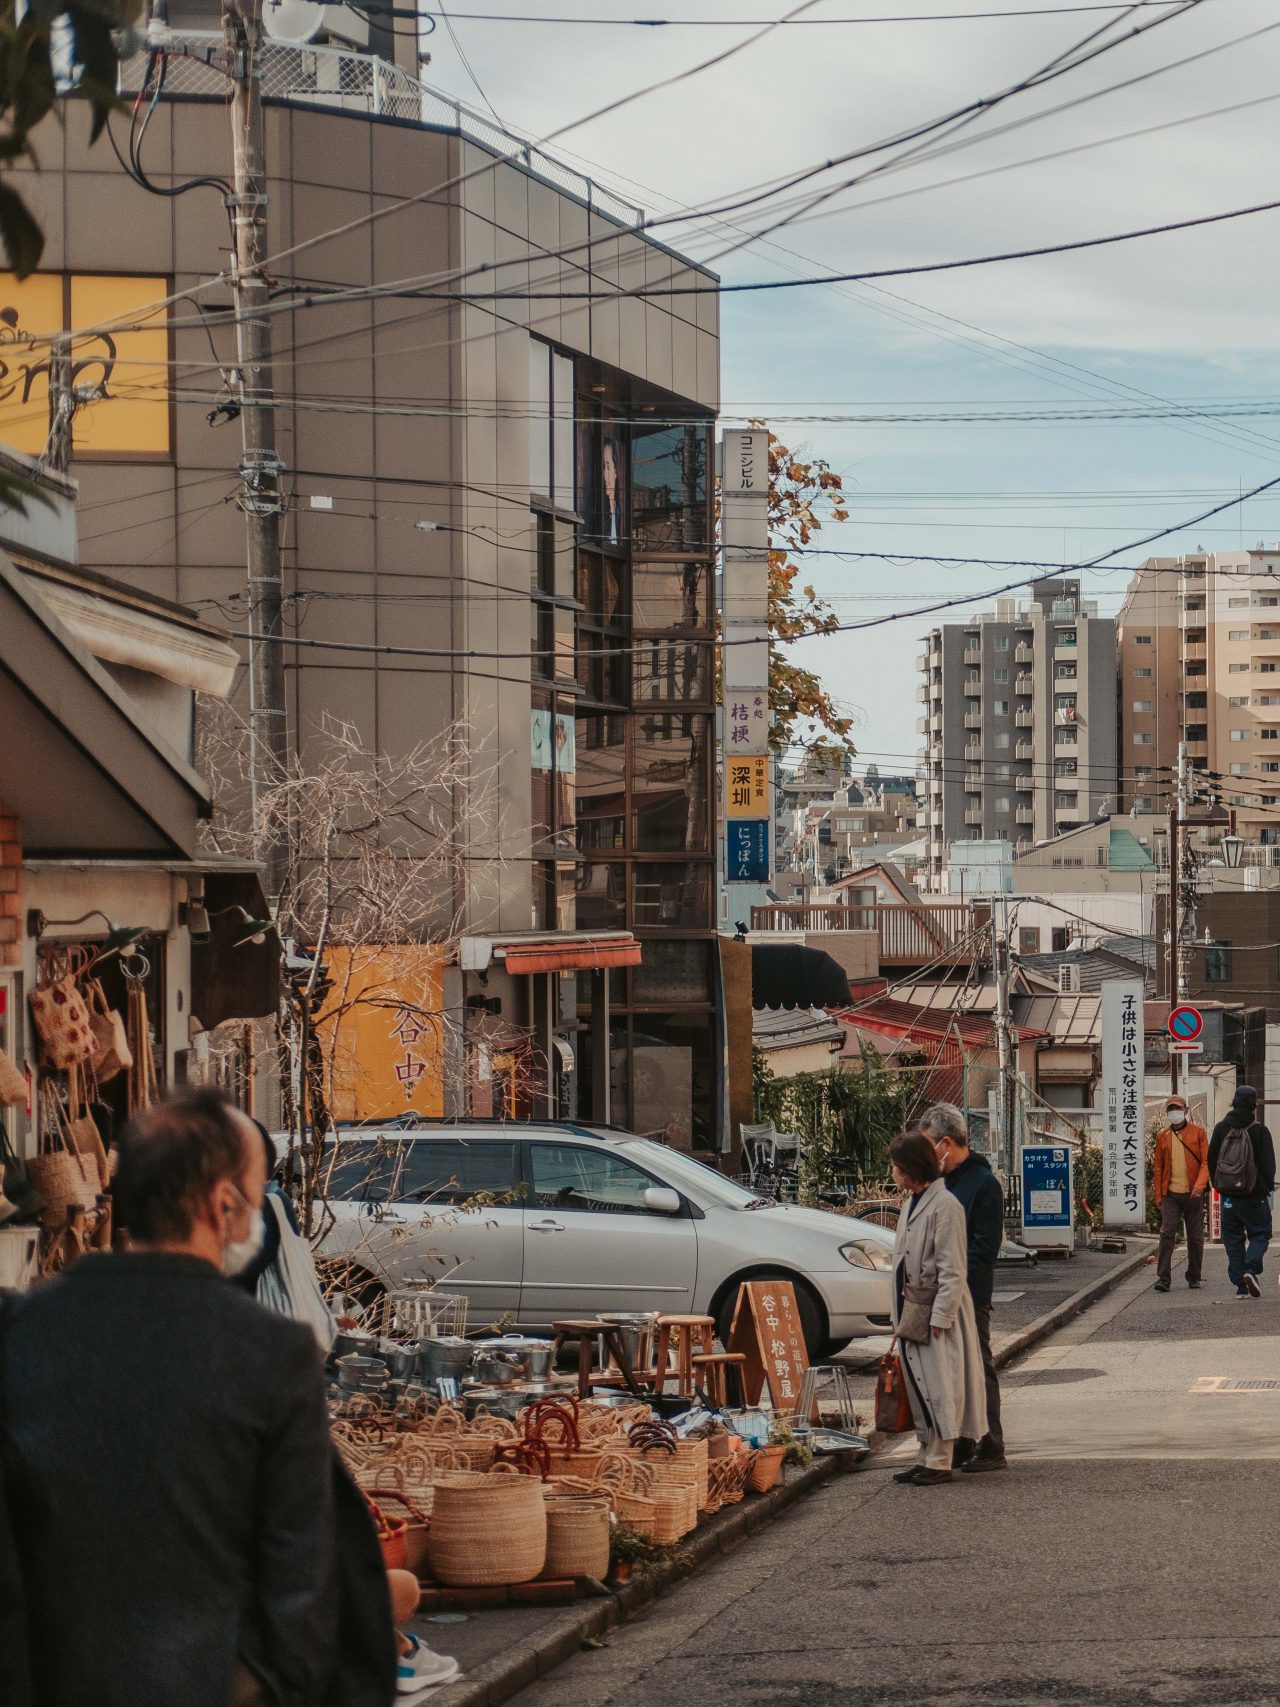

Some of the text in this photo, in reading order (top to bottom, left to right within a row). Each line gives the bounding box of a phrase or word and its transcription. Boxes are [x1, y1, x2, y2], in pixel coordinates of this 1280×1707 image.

[740, 436, 754, 489] コニシビル
[731, 702, 750, 744] 桔梗
[732, 766, 751, 807] 深圳
[755, 759, 764, 797] 中華定食
[738, 826, 751, 877] にっぽん
[1121, 994, 1138, 1213] 子供は小さな注意で大きく育つ
[1108, 1087, 1118, 1197] 荒川警察署 町会青少年部
[761, 1294, 795, 1398] 谷中 松野屋
